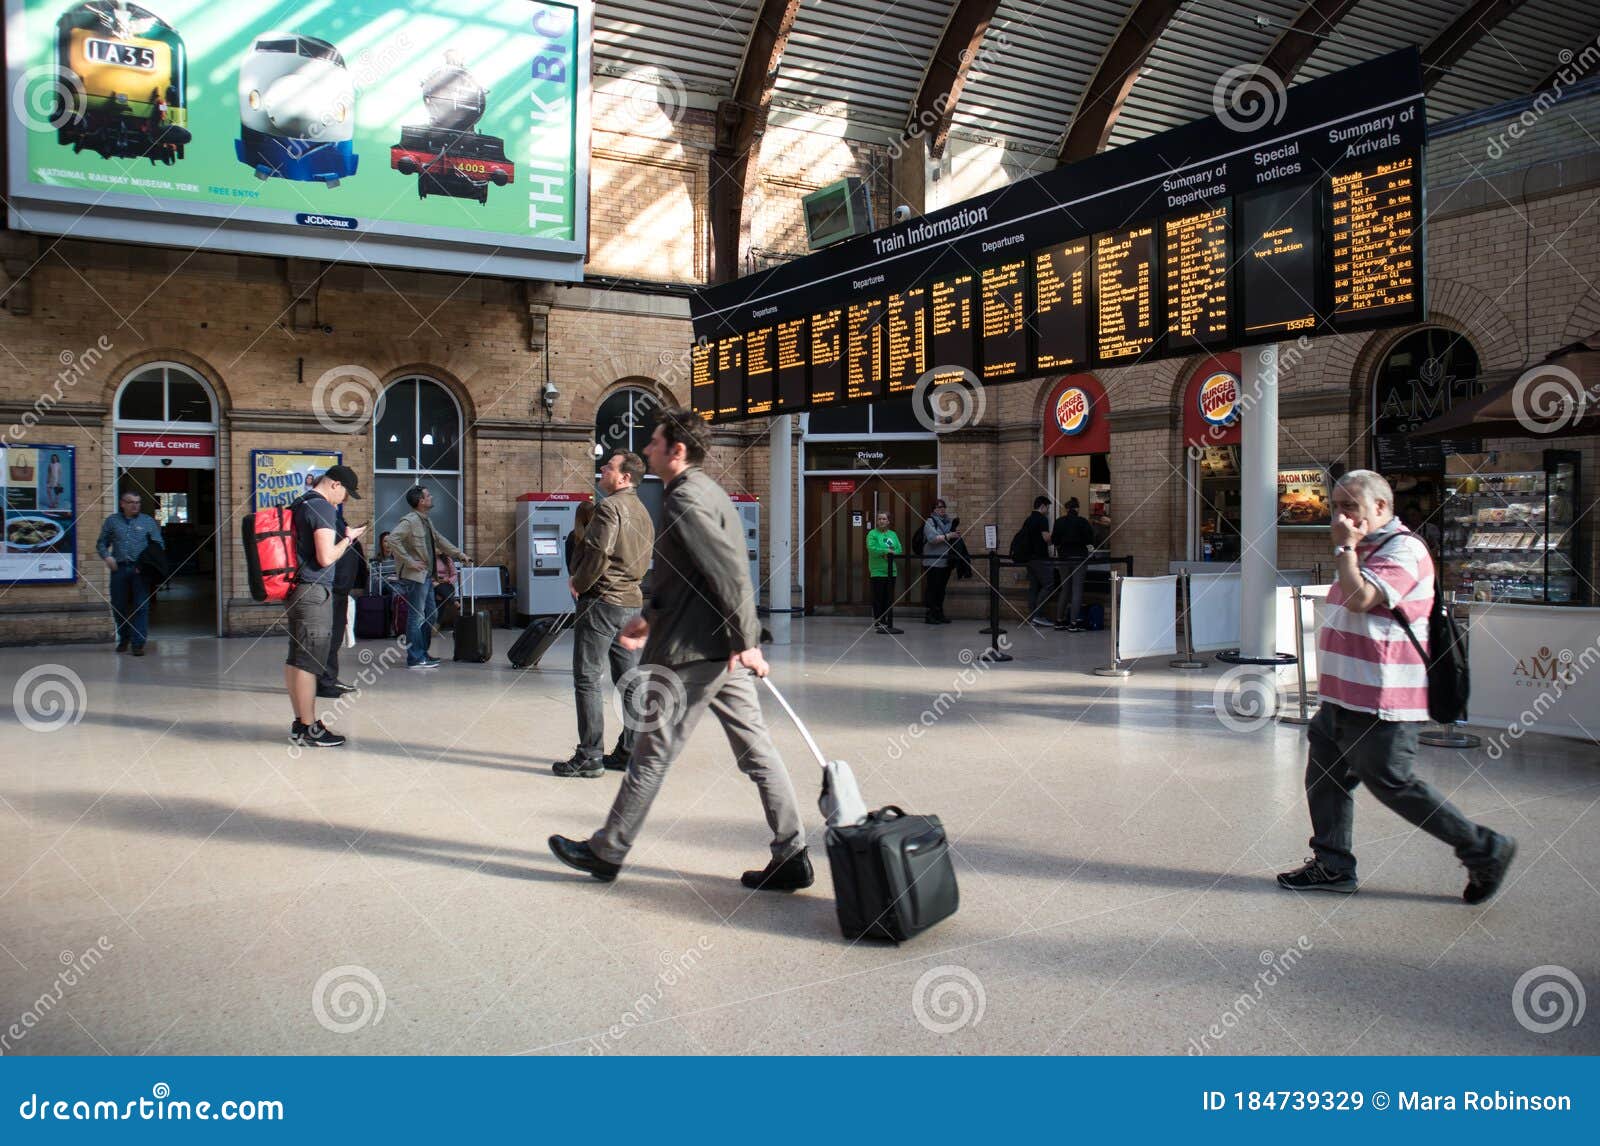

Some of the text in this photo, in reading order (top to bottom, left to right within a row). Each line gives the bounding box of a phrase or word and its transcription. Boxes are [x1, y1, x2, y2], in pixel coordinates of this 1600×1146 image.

[92, 41, 153, 68] 1A35
[1329, 106, 1416, 143] Summary of
[1254, 142, 1300, 167] Special
[1346, 132, 1401, 158] Arrivals
[458, 162, 485, 174] 4003
[529, 91, 566, 229] THINK
[38, 167, 85, 181] NATIONAL
[88, 173, 129, 186] RAILWAY
[175, 182, 199, 193] YORK
[1163, 163, 1228, 192] Summary of
[1256, 162, 1302, 184] notices
[1332, 171, 1362, 185] Arrivals
[208, 185, 260, 199] FREE ENTRY
[1167, 182, 1227, 208] Departures
[304, 215, 350, 228] JCDecaux
[873, 206, 988, 255] Train Information
[982, 232, 1025, 253] Departures
[1254, 243, 1303, 258] York Station
[853, 274, 885, 290] Departures
[753, 306, 778, 319] Departures
[1202, 380, 1235, 403] BURGER
[1202, 389, 1237, 416] KING
[1057, 393, 1082, 416] BURGER
[1059, 400, 1085, 426] KING
[133, 441, 200, 449] TRAVEL CENTRE
[858, 451, 884, 459] Private
[258, 472, 303, 489] SOUND
[1301, 473, 1321, 483] KING
